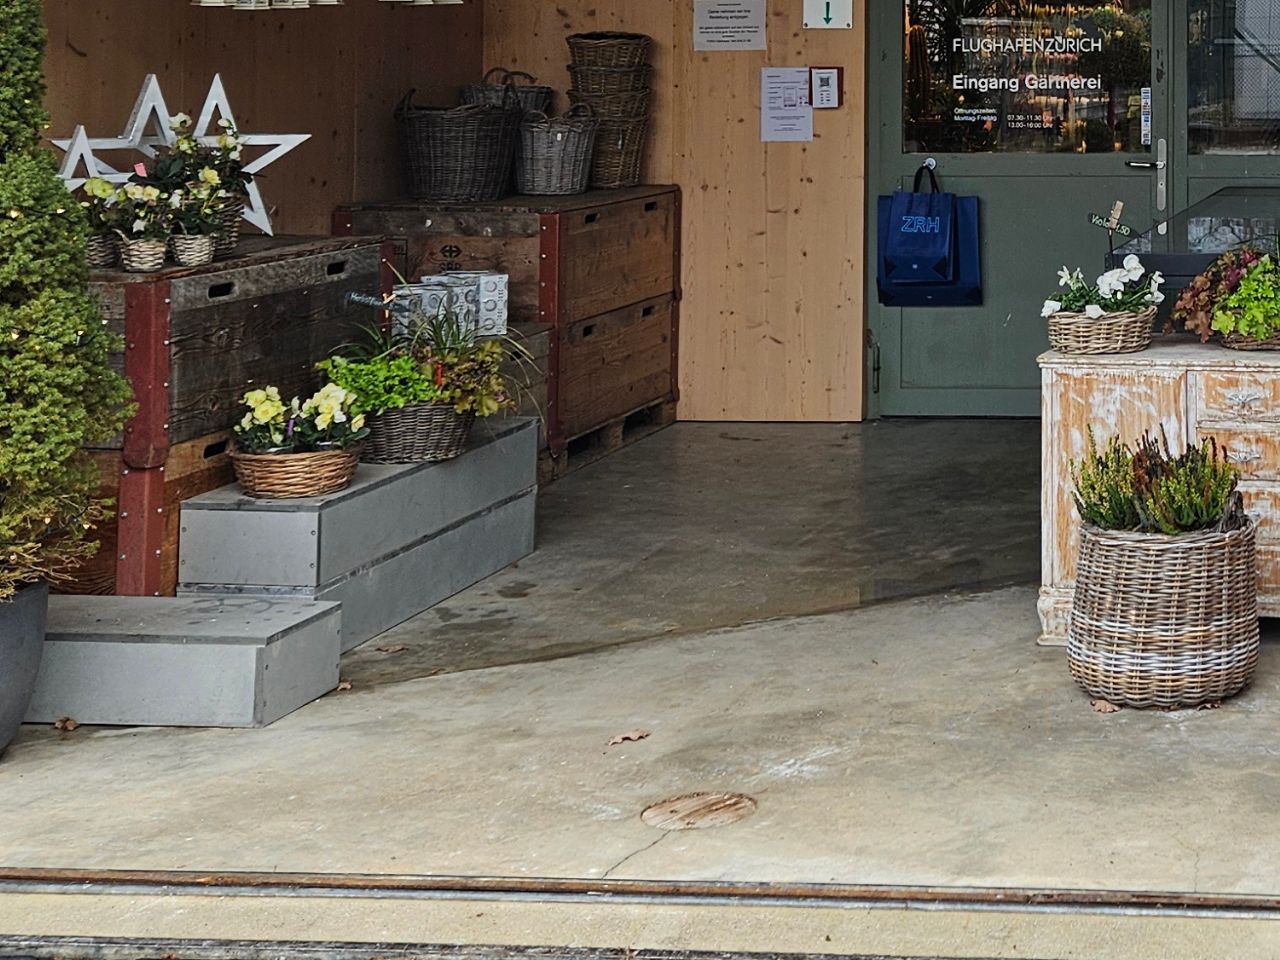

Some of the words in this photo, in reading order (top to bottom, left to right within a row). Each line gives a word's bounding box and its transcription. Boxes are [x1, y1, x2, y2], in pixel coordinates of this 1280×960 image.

[952, 74, 1019, 91] Eingang
[1024, 74, 1101, 90] Gärtnerei
[901, 216, 940, 233] ZRH
